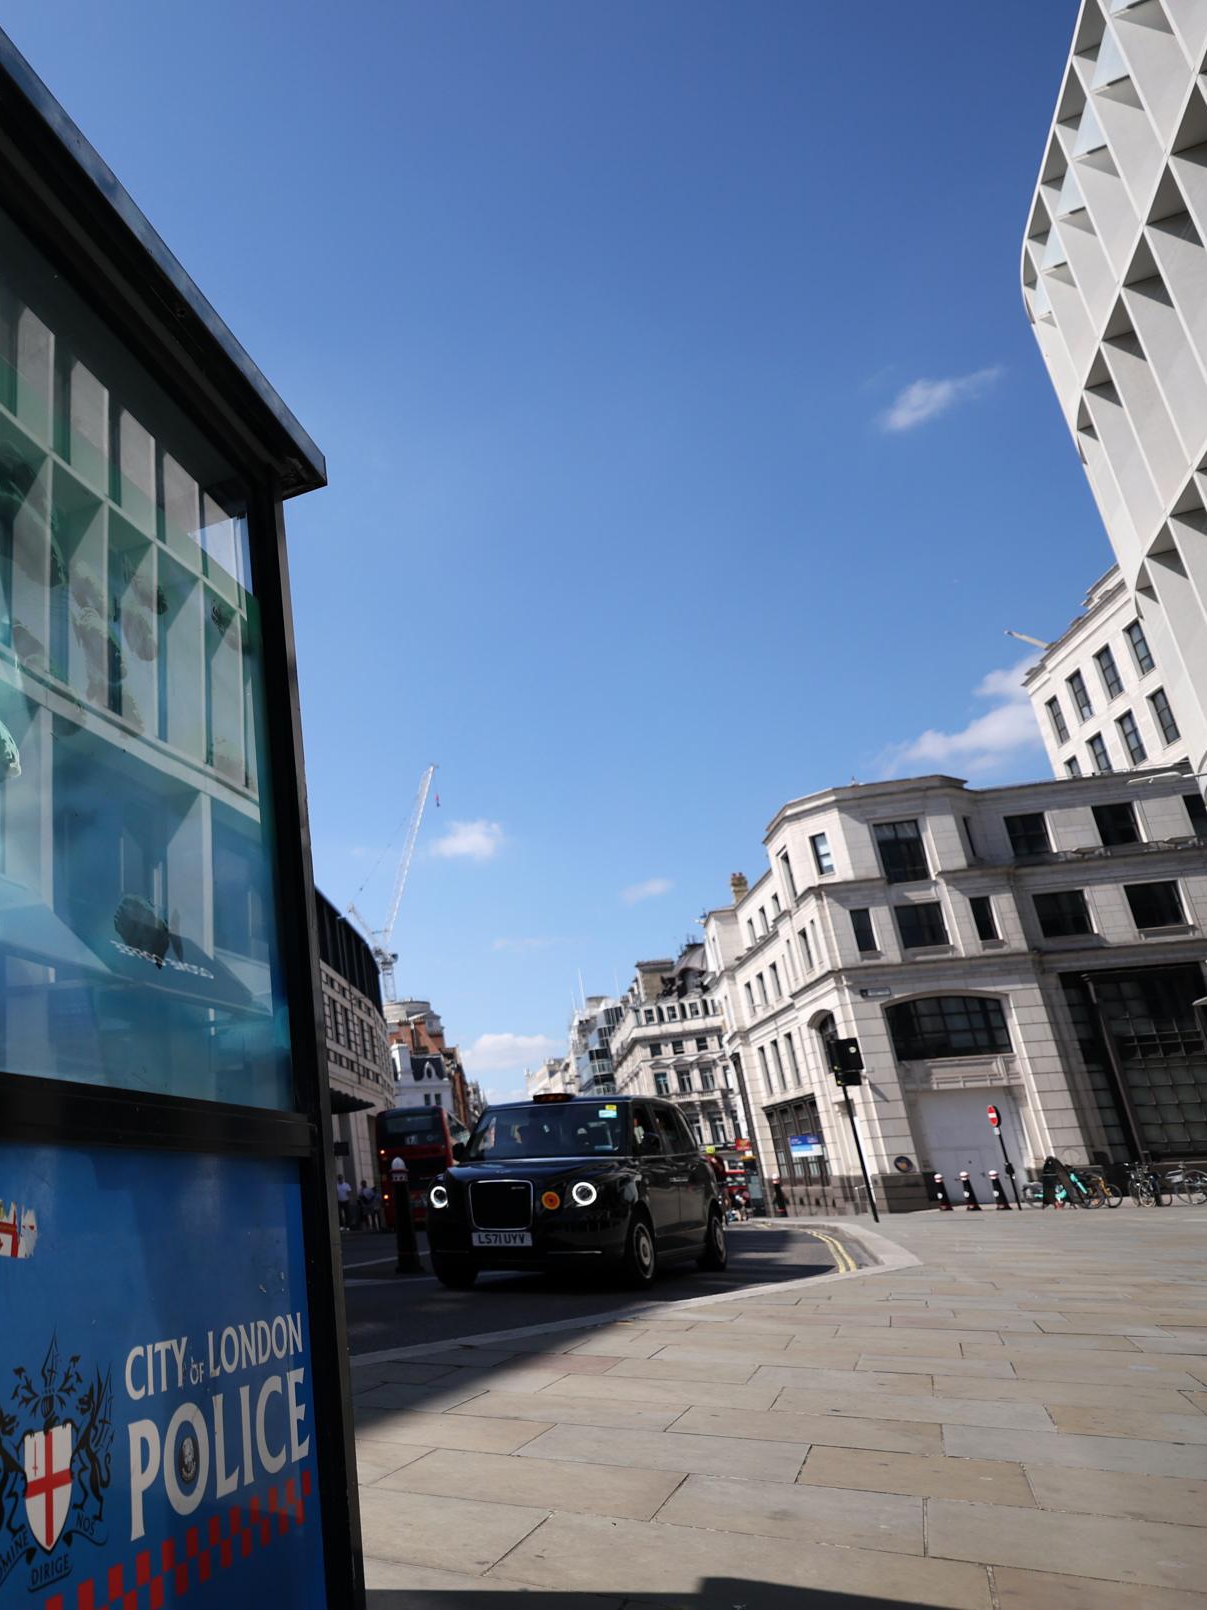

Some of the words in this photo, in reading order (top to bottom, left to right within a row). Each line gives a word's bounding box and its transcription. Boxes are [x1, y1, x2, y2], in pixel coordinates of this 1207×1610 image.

[125, 1336, 188, 1401] CITY
[189, 1361, 204, 1385] OF
[207, 1311, 304, 1379] LONDON
[128, 1367, 310, 1542] POLICE
[31, 1553, 71, 1586] DIRIGE
[75, 1511, 95, 1537] NOS
